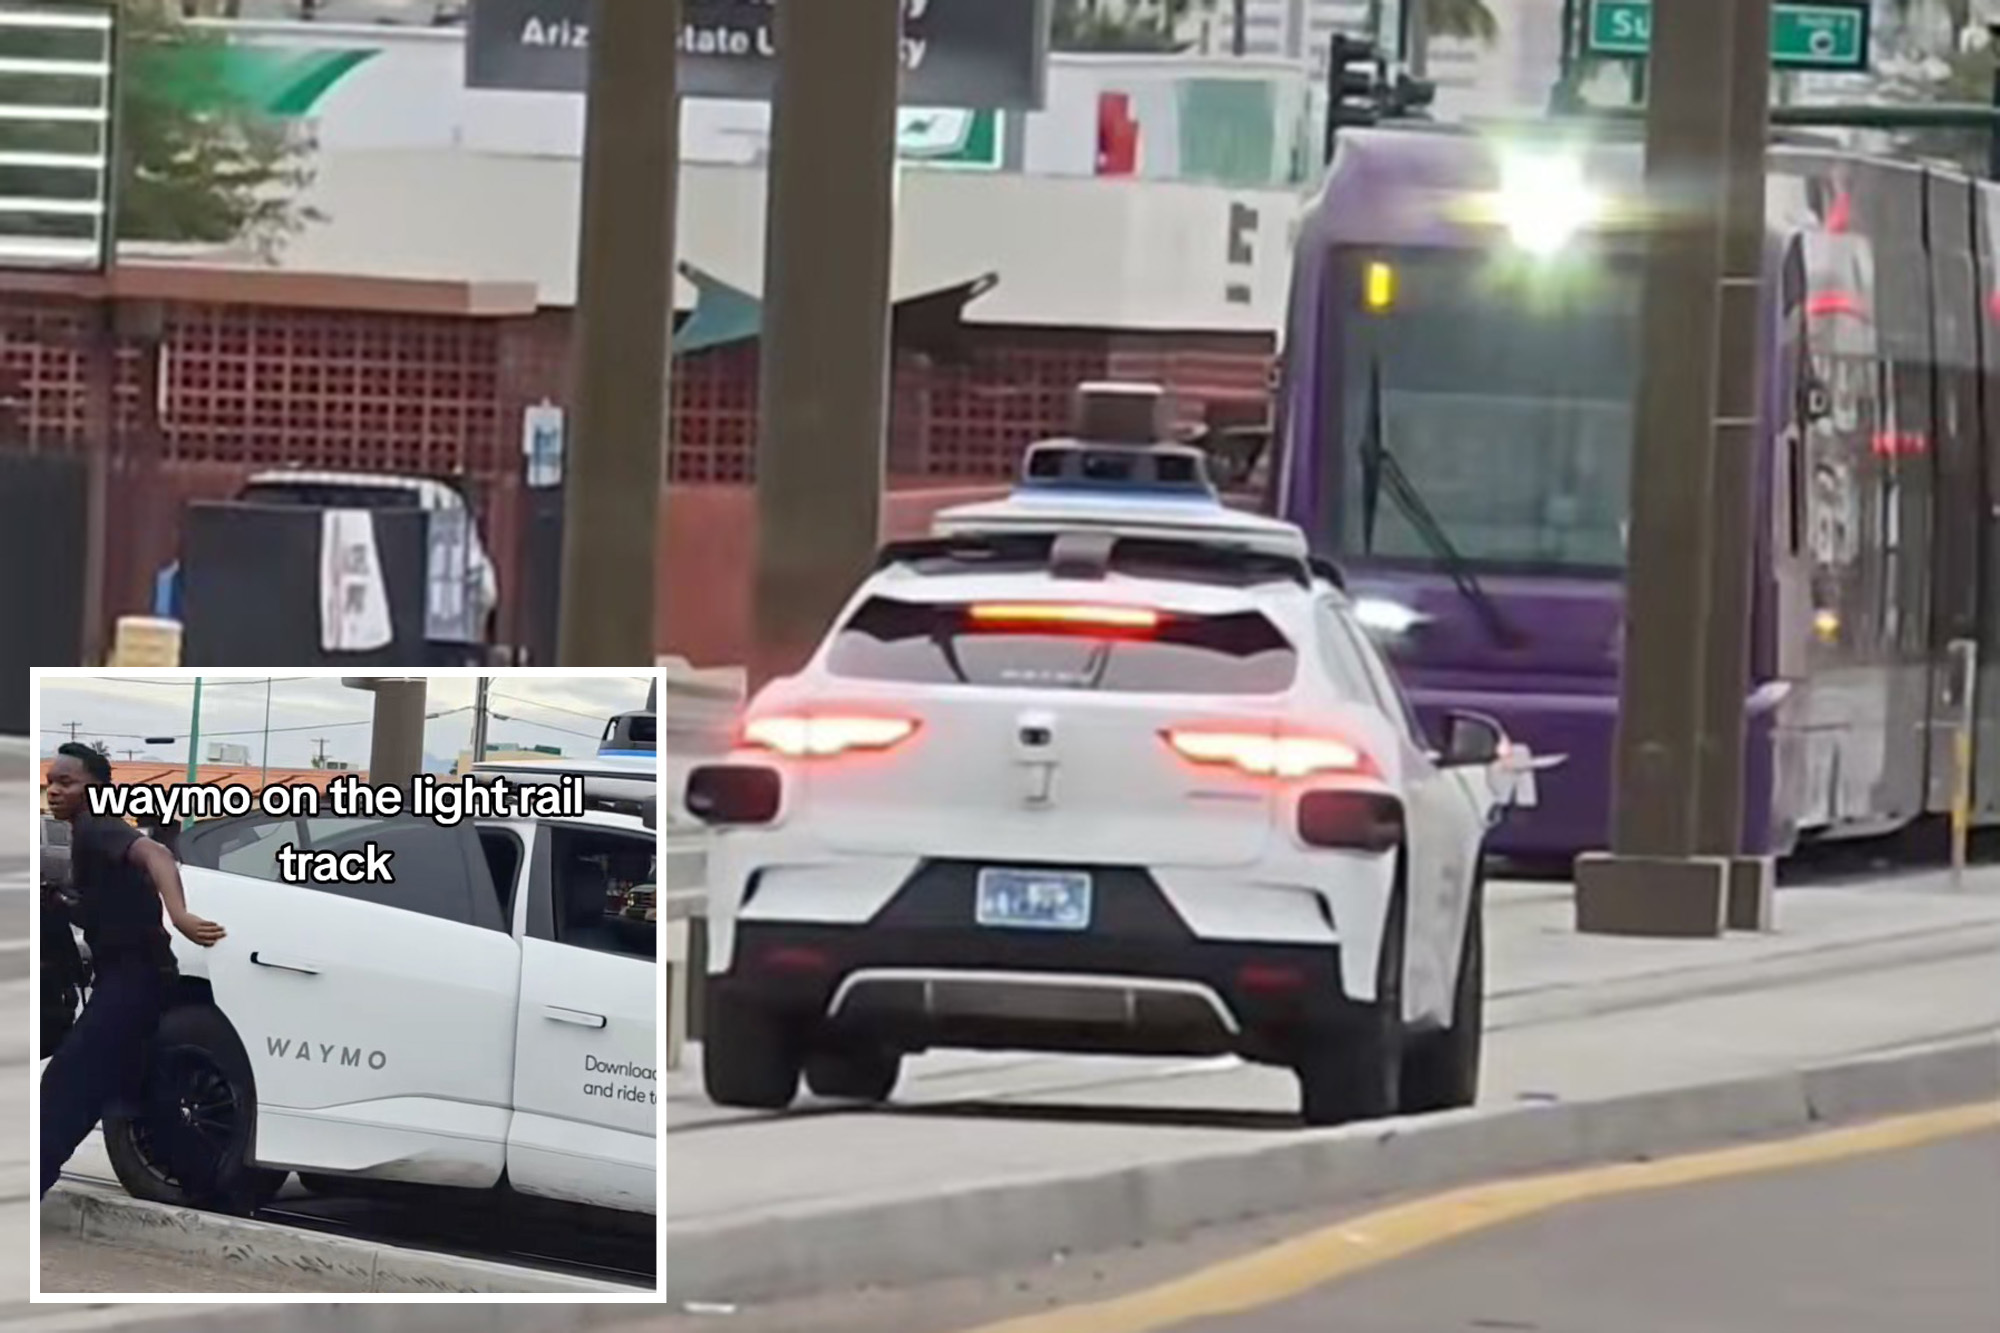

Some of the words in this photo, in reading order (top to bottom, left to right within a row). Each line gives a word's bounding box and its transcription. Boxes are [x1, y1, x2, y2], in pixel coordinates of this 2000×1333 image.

[520, 16, 591, 48] Ariz
[674, 24, 749, 53] tate
[265, 1036, 388, 1070] WAYMO
[583, 1081, 614, 1098] and
[617, 1084, 646, 1103] ride
[649, 1090, 657, 1105] t
